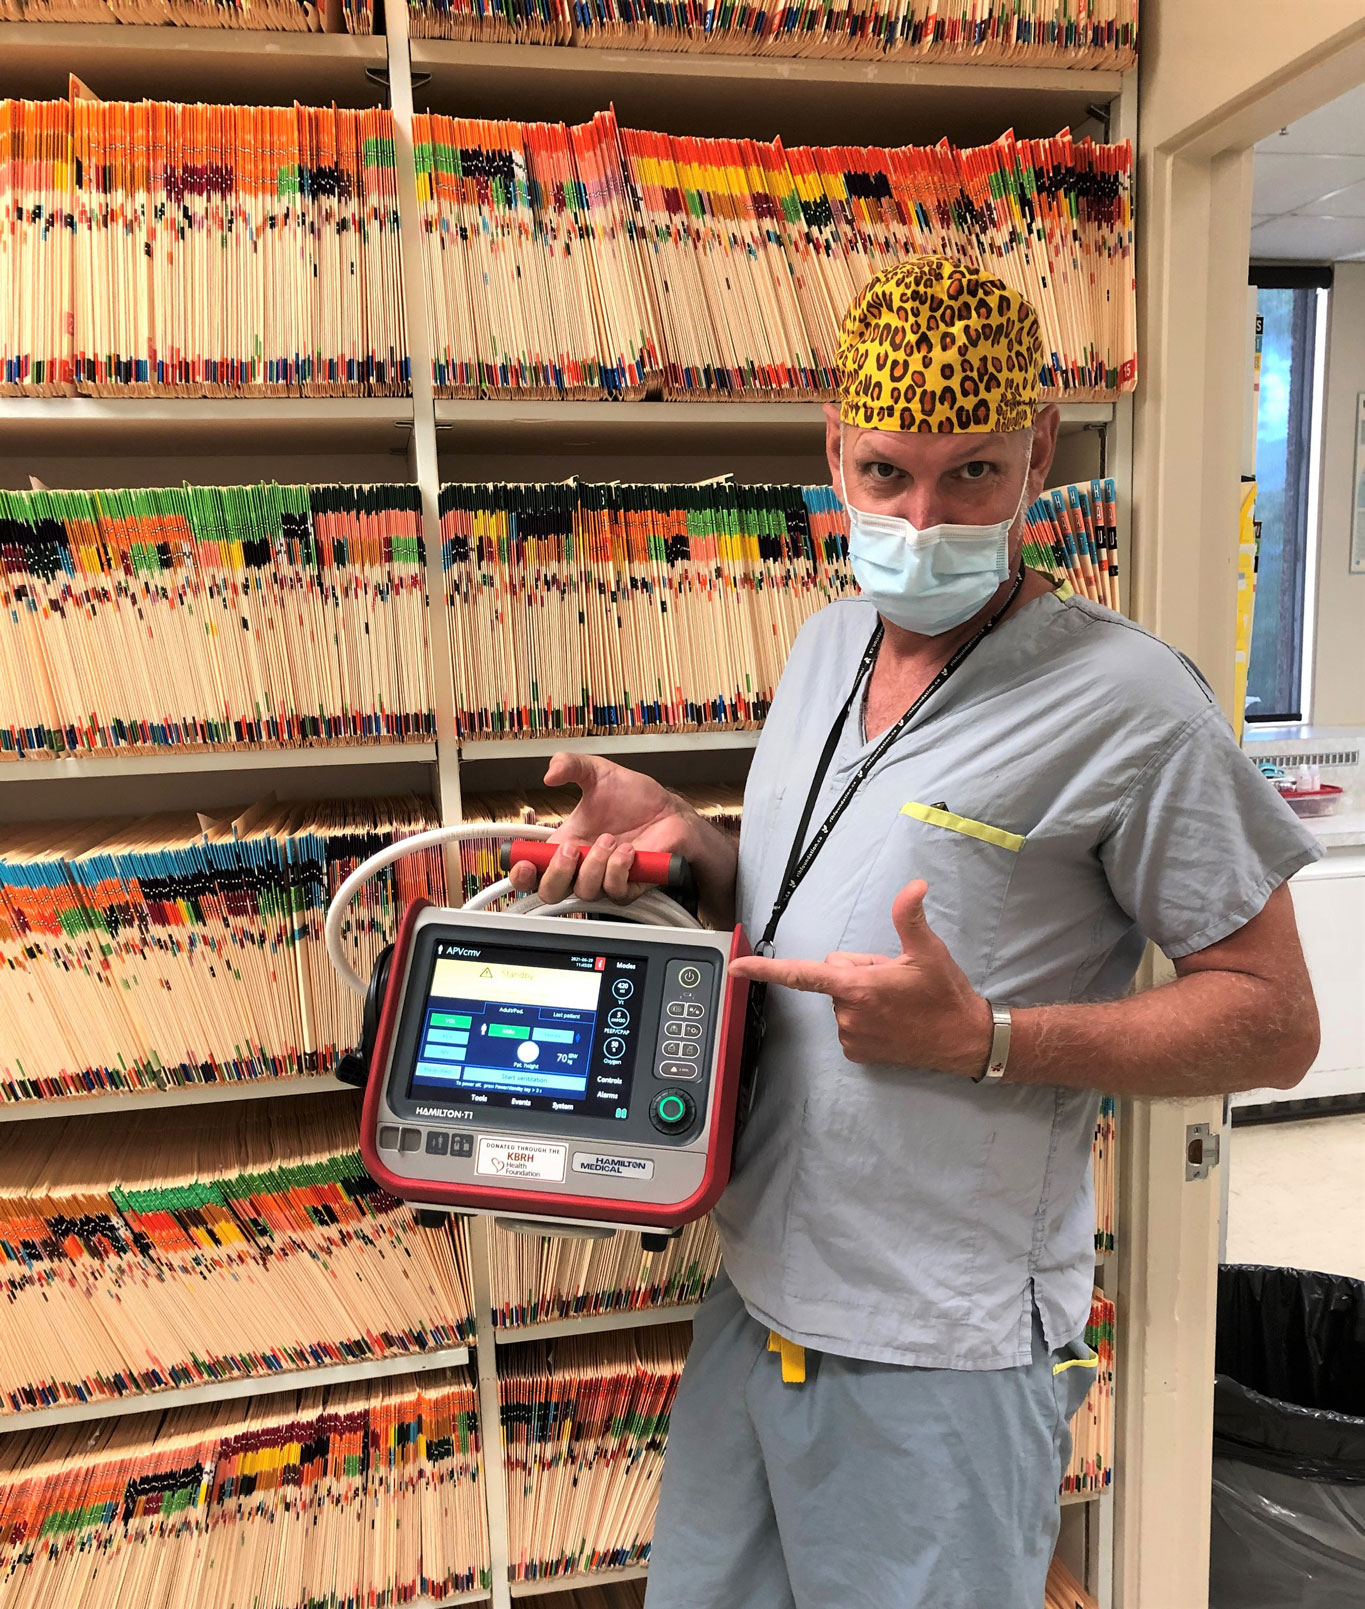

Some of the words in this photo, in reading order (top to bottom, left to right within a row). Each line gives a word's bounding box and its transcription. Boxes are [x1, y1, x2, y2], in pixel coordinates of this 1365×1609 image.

[446, 946, 481, 958] APVcmv
[616, 962, 636, 970] Modes
[563, 1012, 581, 1020] patient
[604, 1028, 630, 1036] PEEP/CPAP
[556, 1053, 568, 1063] 70
[603, 1058, 622, 1066] Oxygen
[523, 1062, 539, 1070] height
[501, 1073, 516, 1081] Start
[517, 1075, 548, 1084] ventilation
[596, 1075, 623, 1085] Controls
[596, 1090, 619, 1100] Alarms
[471, 1093, 488, 1103] Tools
[511, 1097, 532, 1107] Events
[552, 1101, 574, 1110] System
[486, 1142, 516, 1151] DONATED
[517, 1145, 547, 1154] THROUGH
[507, 1152, 535, 1163] KBRH
[506, 1161, 528, 1170] Health
[580, 1162, 623, 1174] MEDICAL
[595, 1157, 646, 1170] HAMILTON
[505, 1169, 541, 1178] Foundation
